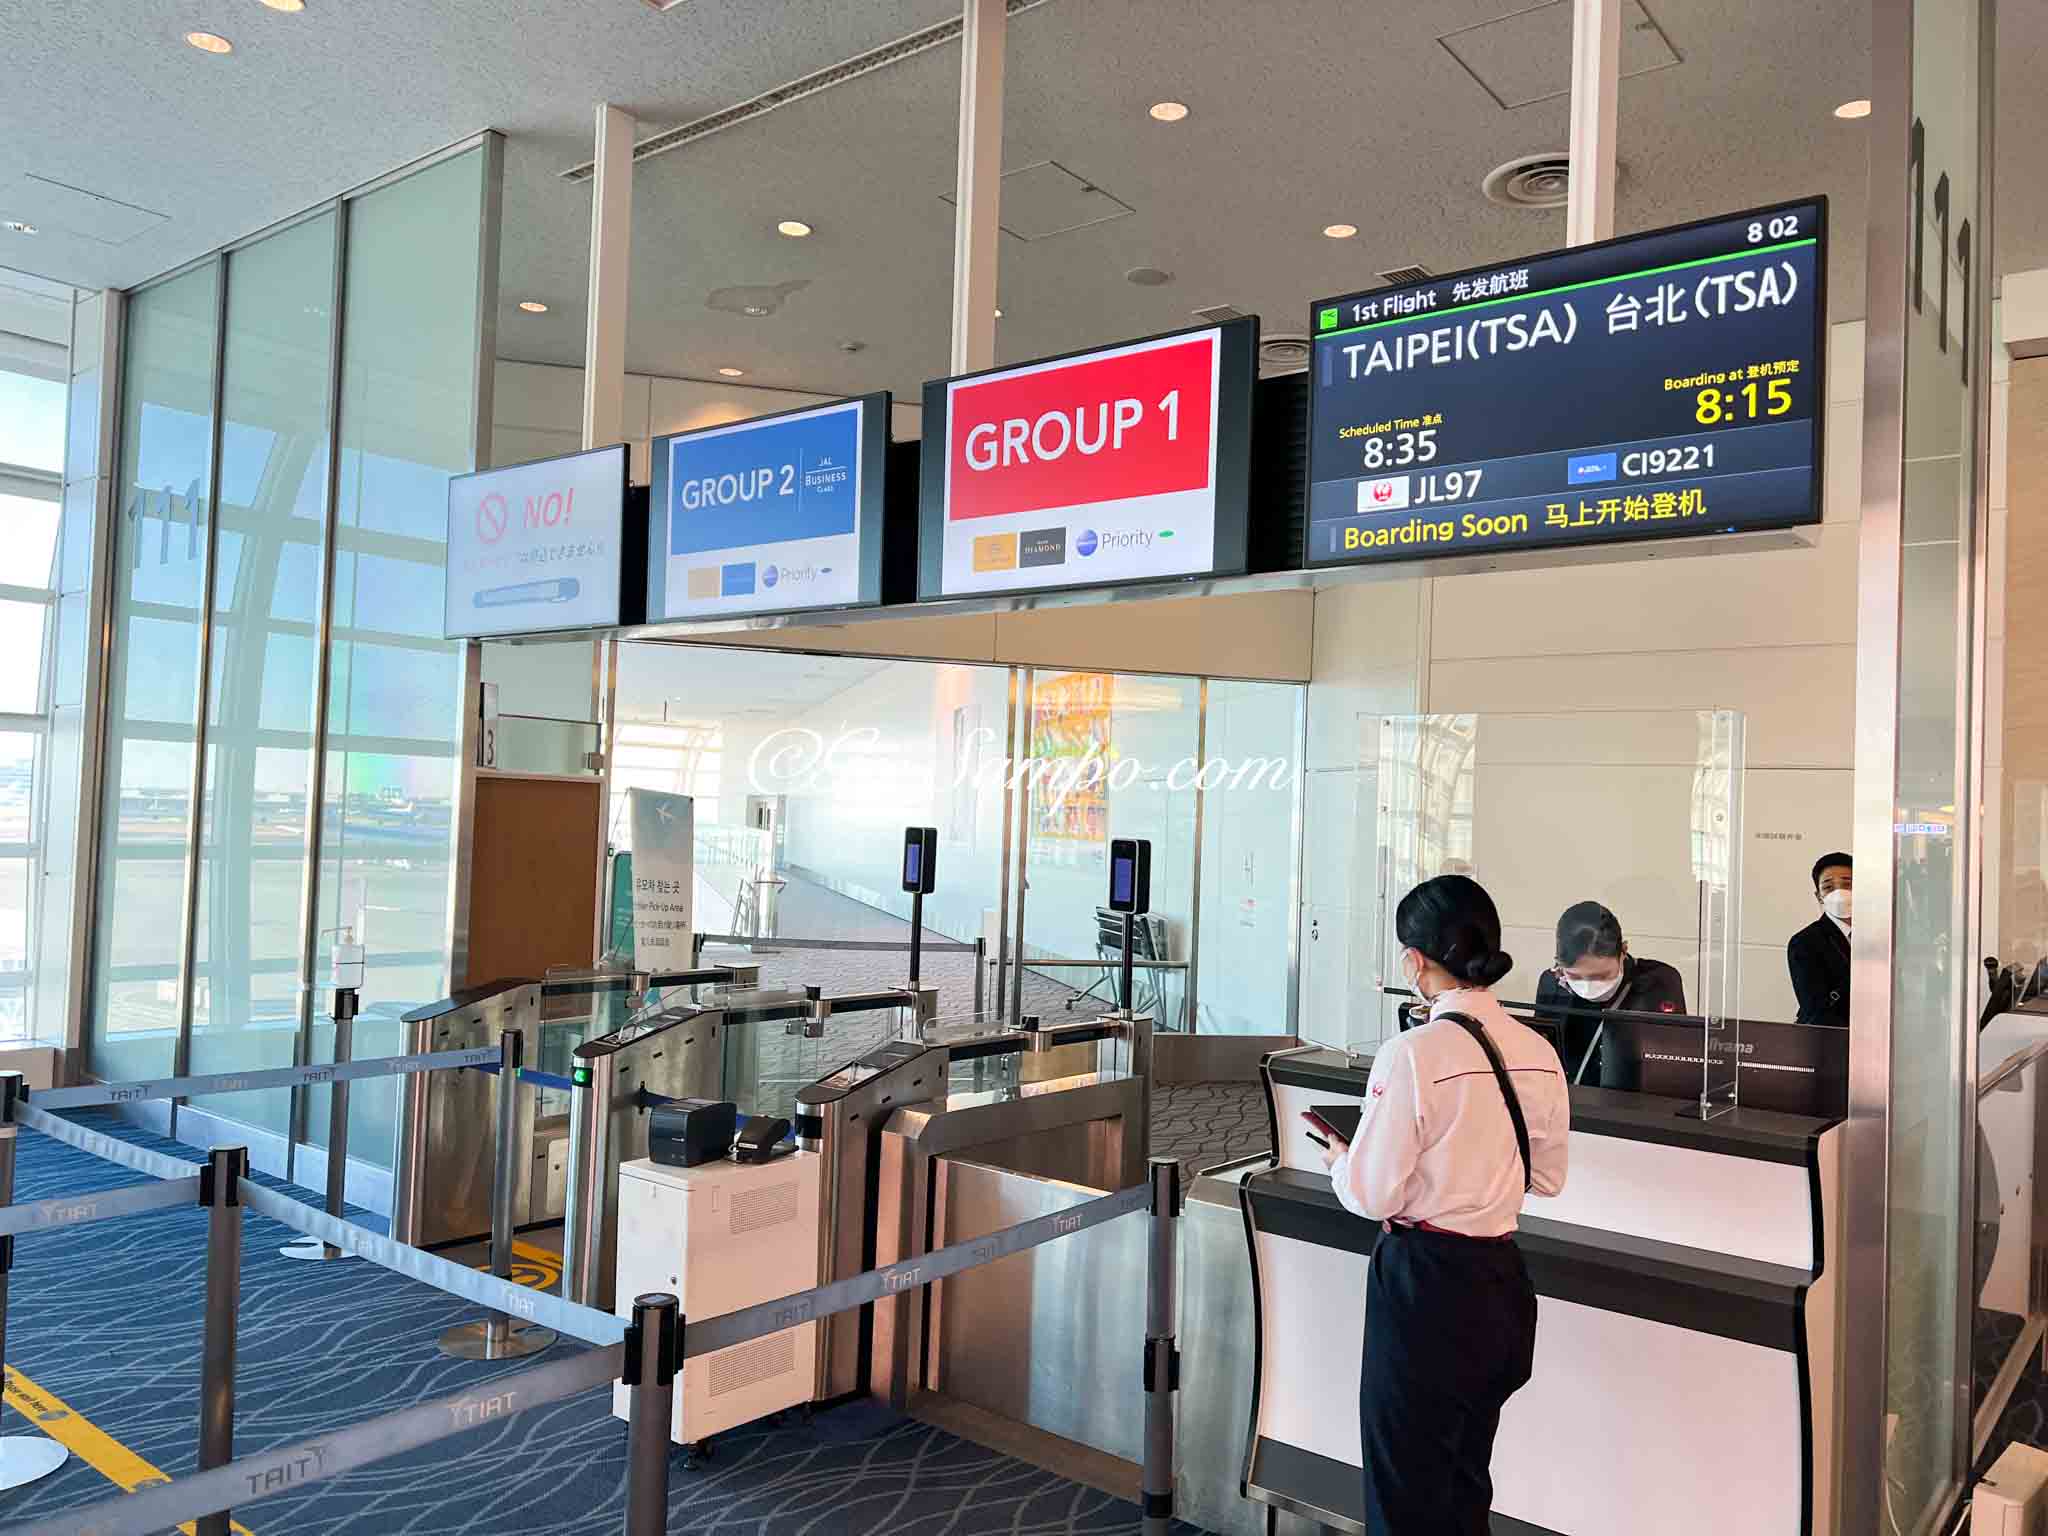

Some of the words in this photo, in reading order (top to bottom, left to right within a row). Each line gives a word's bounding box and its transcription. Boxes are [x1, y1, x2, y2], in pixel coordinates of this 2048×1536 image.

[1352, 303, 1378, 322] 1st
[1383, 289, 1437, 317] Flight
[1452, 269, 1529, 302] 先发航班
[1342, 303, 1577, 380] TAIPEI(TSA)
[1664, 371, 1726, 391] Boarding
[1729, 367, 1744, 381] at
[1747, 359, 1800, 379] 登机预定
[1695, 378, 1793, 425] 8:15
[965, 397, 1144, 472] GROUP
[1157, 389, 1180, 441] 1
[1339, 420, 1392, 439] Scheduled
[1394, 417, 1420, 431] Time
[1422, 413, 1443, 426] 准点
[1363, 429, 1438, 469] 8:35
[1622, 443, 1714, 477] CI9221
[681, 468, 774, 511] GROUP
[778, 464, 796, 496] 2
[805, 471, 848, 487] BUSINESS
[1414, 469, 1483, 504] JL97
[523, 487, 575, 530] NO!
[1344, 519, 1454, 550] Boarding
[1461, 513, 1528, 538] Soon
[1544, 488, 1707, 529] 马上开始登机
[1102, 530, 1153, 550] Priority
[780, 566, 818, 584] Priority
